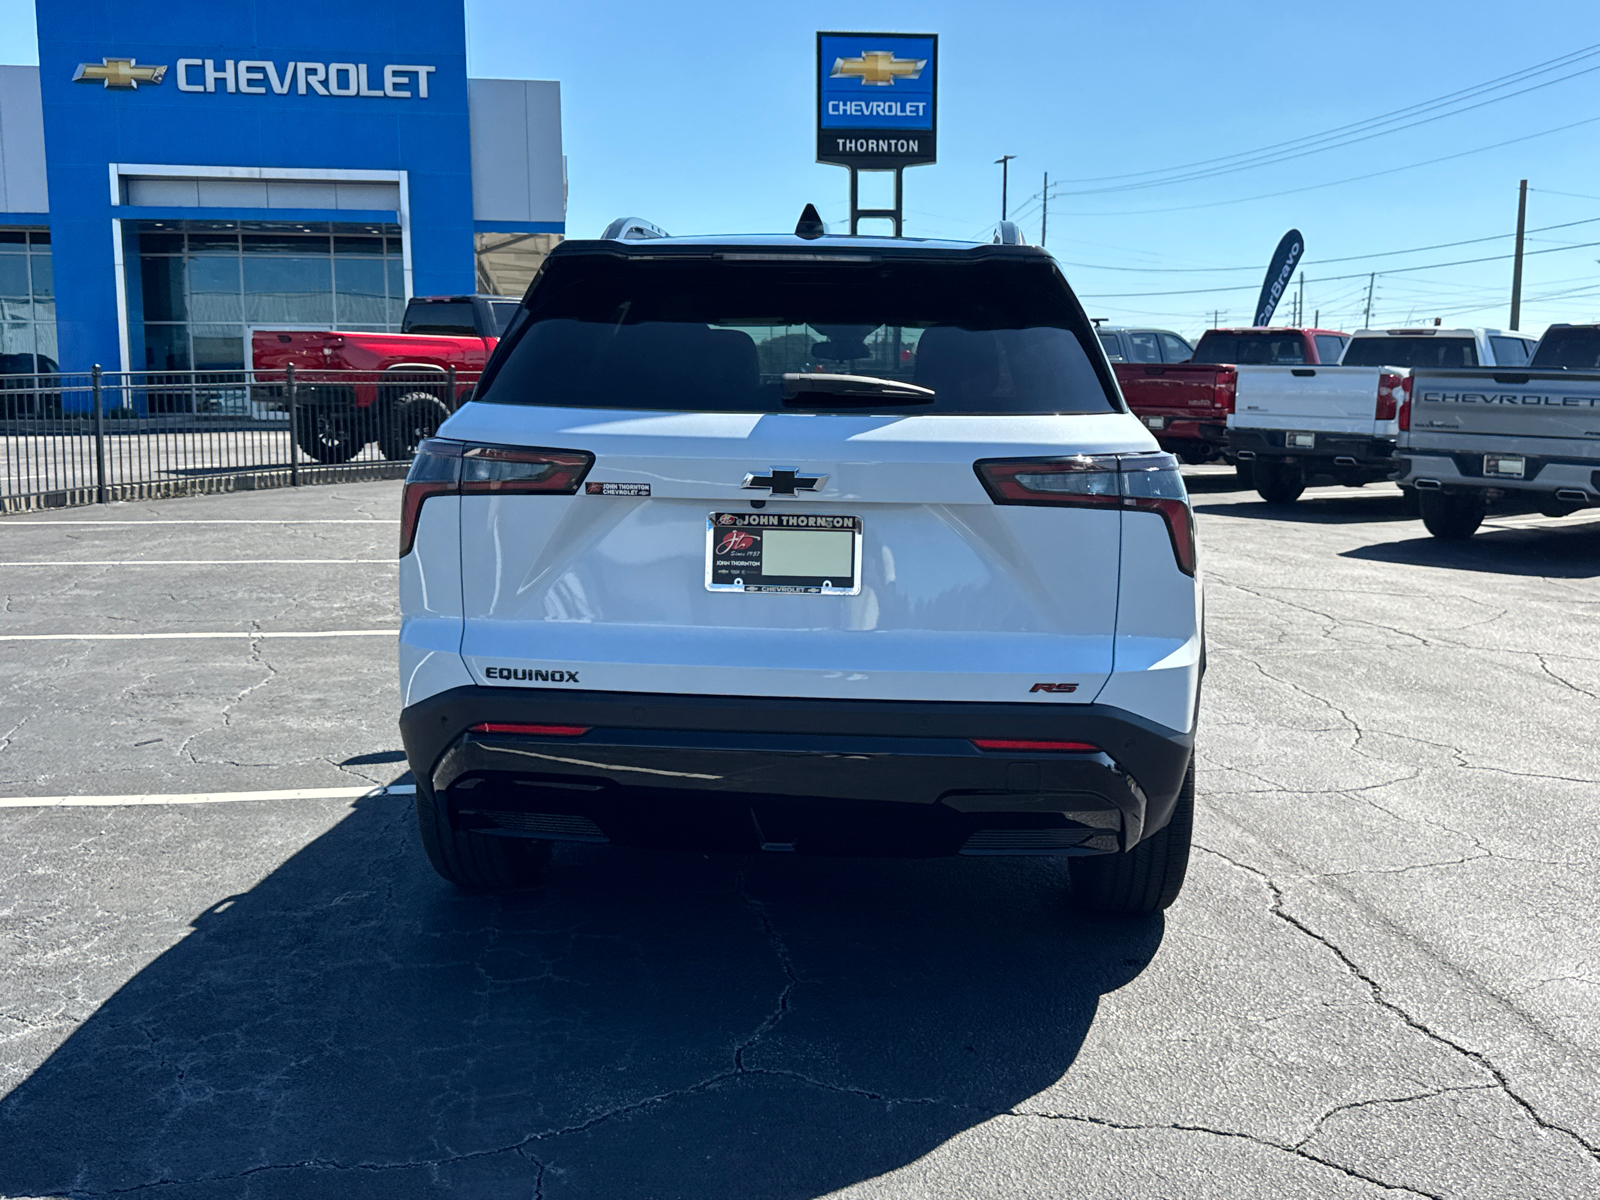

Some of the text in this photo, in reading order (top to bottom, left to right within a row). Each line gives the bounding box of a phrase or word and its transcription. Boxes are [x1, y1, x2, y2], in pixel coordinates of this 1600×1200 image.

[176, 58, 436, 99] CHEVROLET
[828, 101, 927, 116] CHEVROLET
[837, 139, 919, 153] THORNTON
[1258, 242, 1300, 327] CarBravo
[743, 515, 853, 528] JOHN THORNTON
[485, 666, 580, 683] EQUINOX
[1028, 682, 1080, 693] RS
